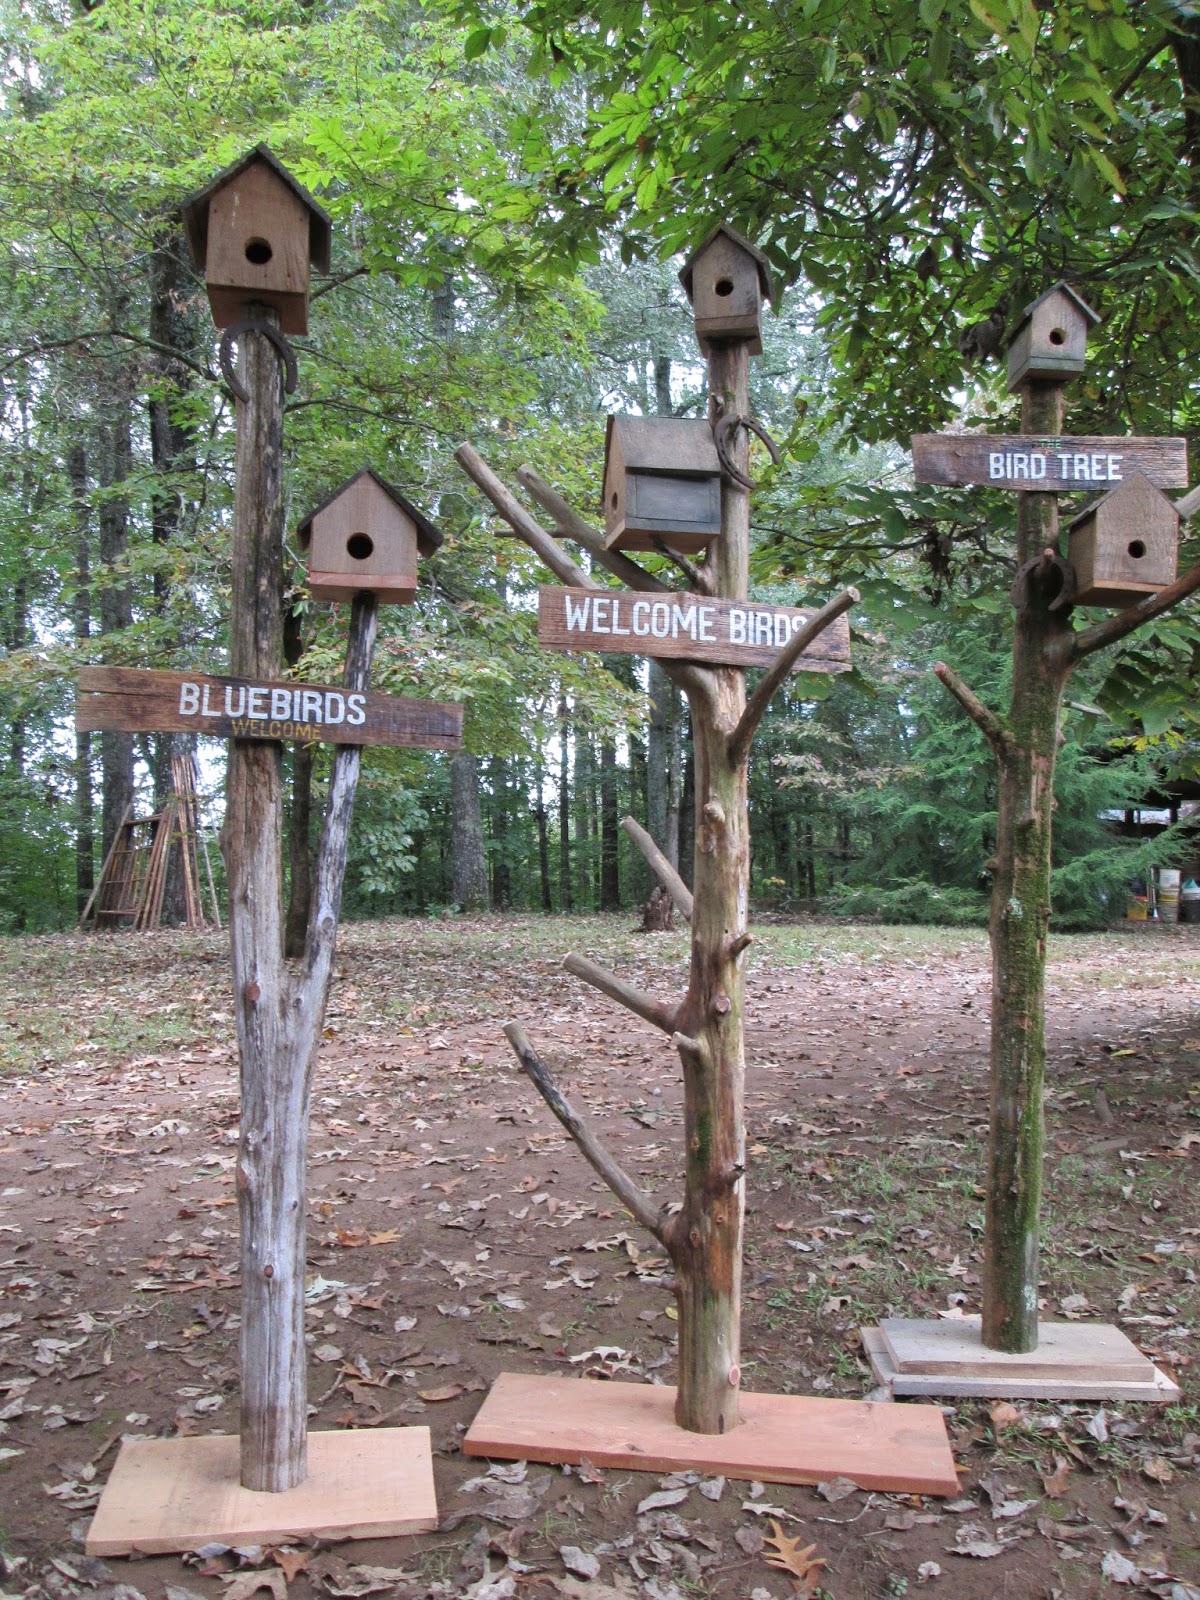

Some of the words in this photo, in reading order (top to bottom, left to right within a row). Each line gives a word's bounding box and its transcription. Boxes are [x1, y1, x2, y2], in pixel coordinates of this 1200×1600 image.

[1039, 438, 1061, 449] THE
[989, 453, 1046, 479] BIRD
[1057, 453, 1124, 480] TREE
[565, 595, 717, 641] WELCOME
[178, 682, 367, 725] BLUEBIRDS
[231, 719, 323, 740] WELCOME
